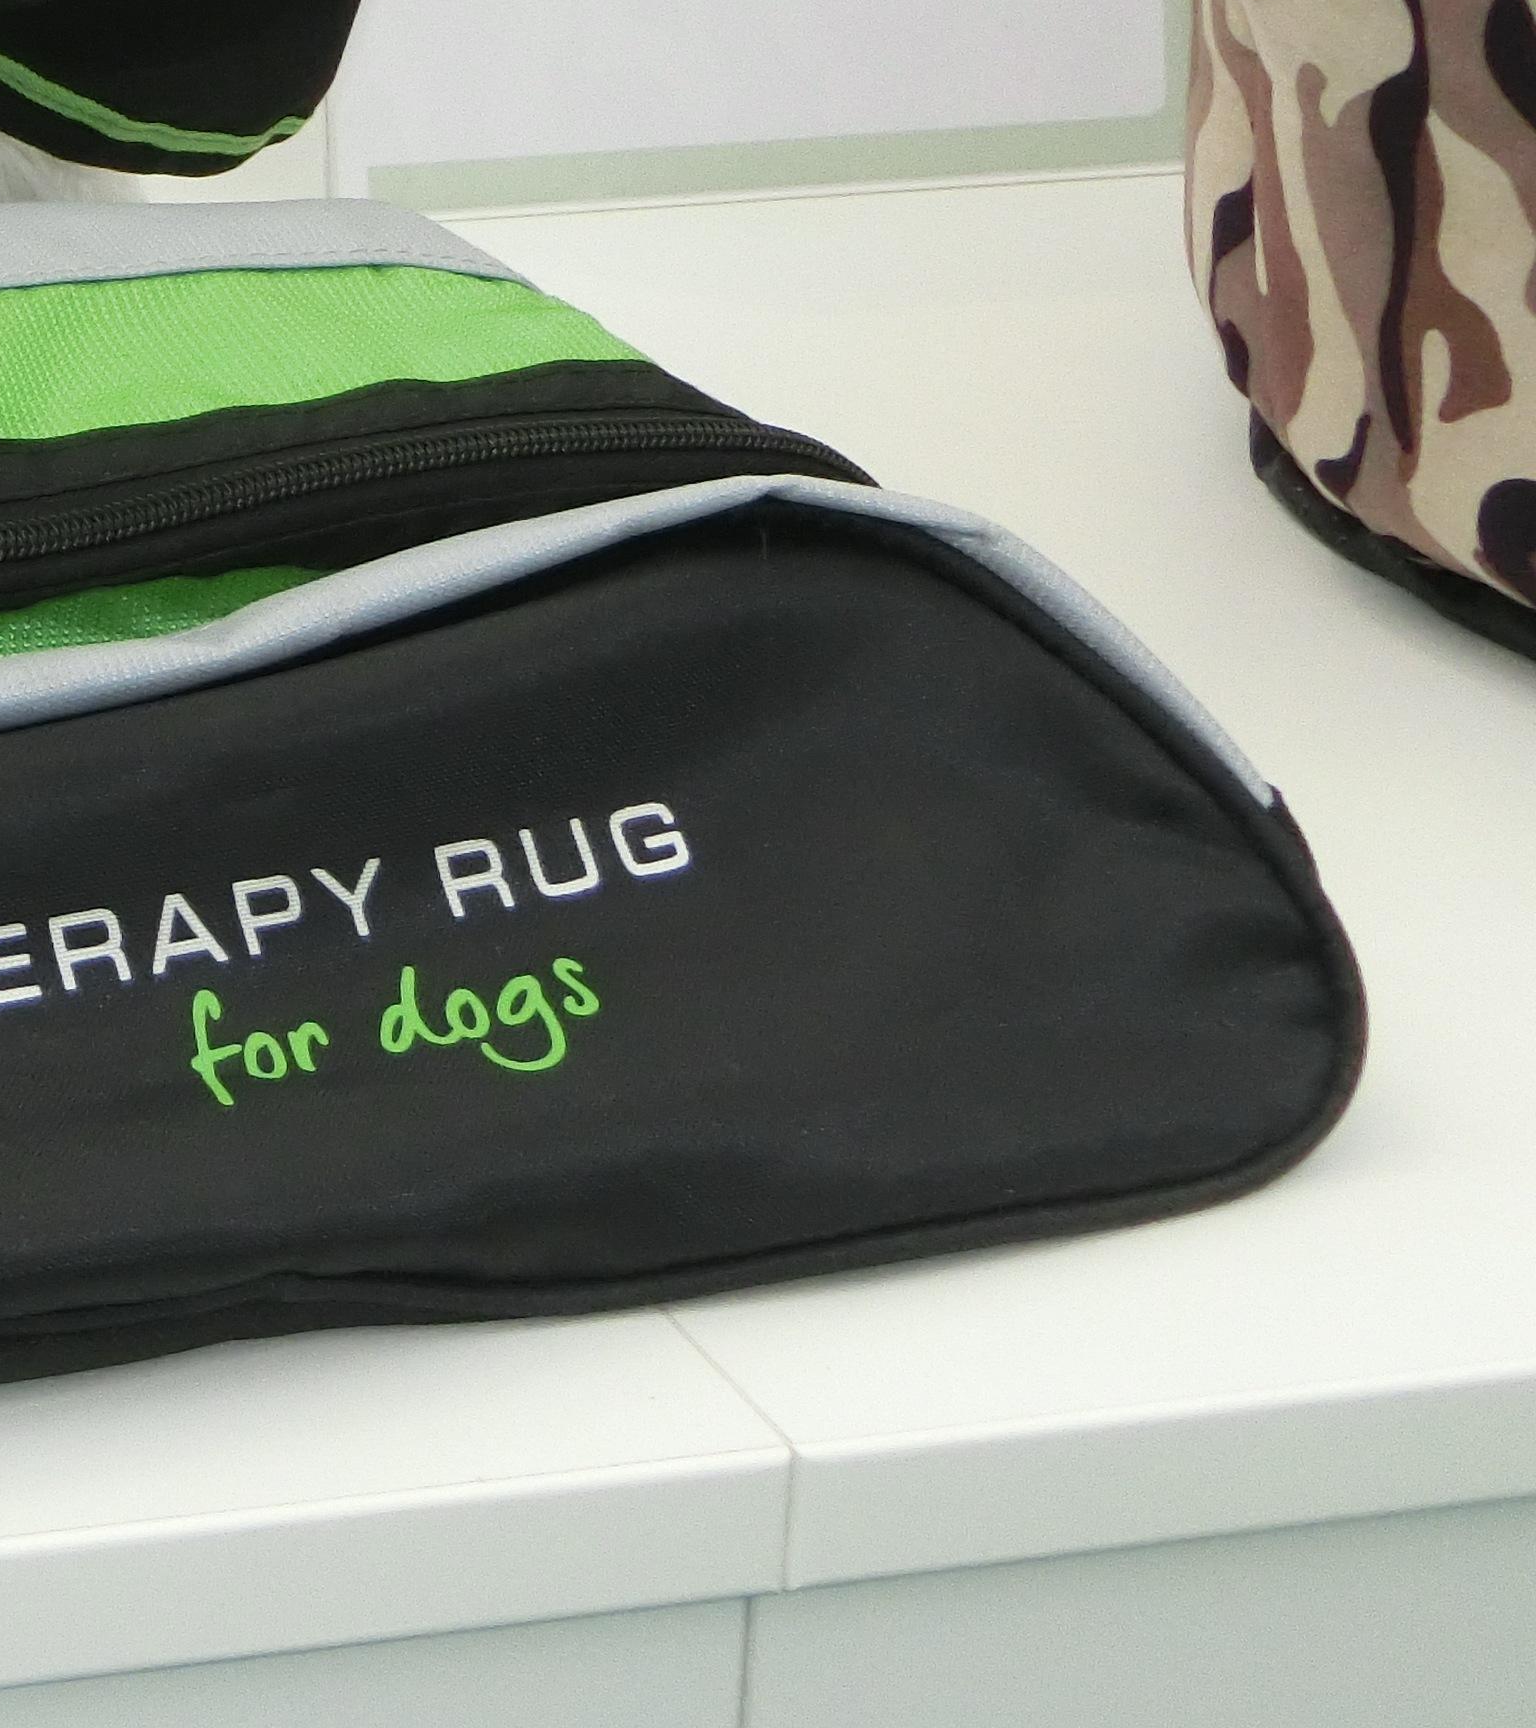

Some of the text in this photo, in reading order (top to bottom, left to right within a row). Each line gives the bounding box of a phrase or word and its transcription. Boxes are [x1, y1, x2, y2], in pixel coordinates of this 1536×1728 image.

[434, 802, 691, 918] RUG
[190, 957, 601, 1106] for dogs
